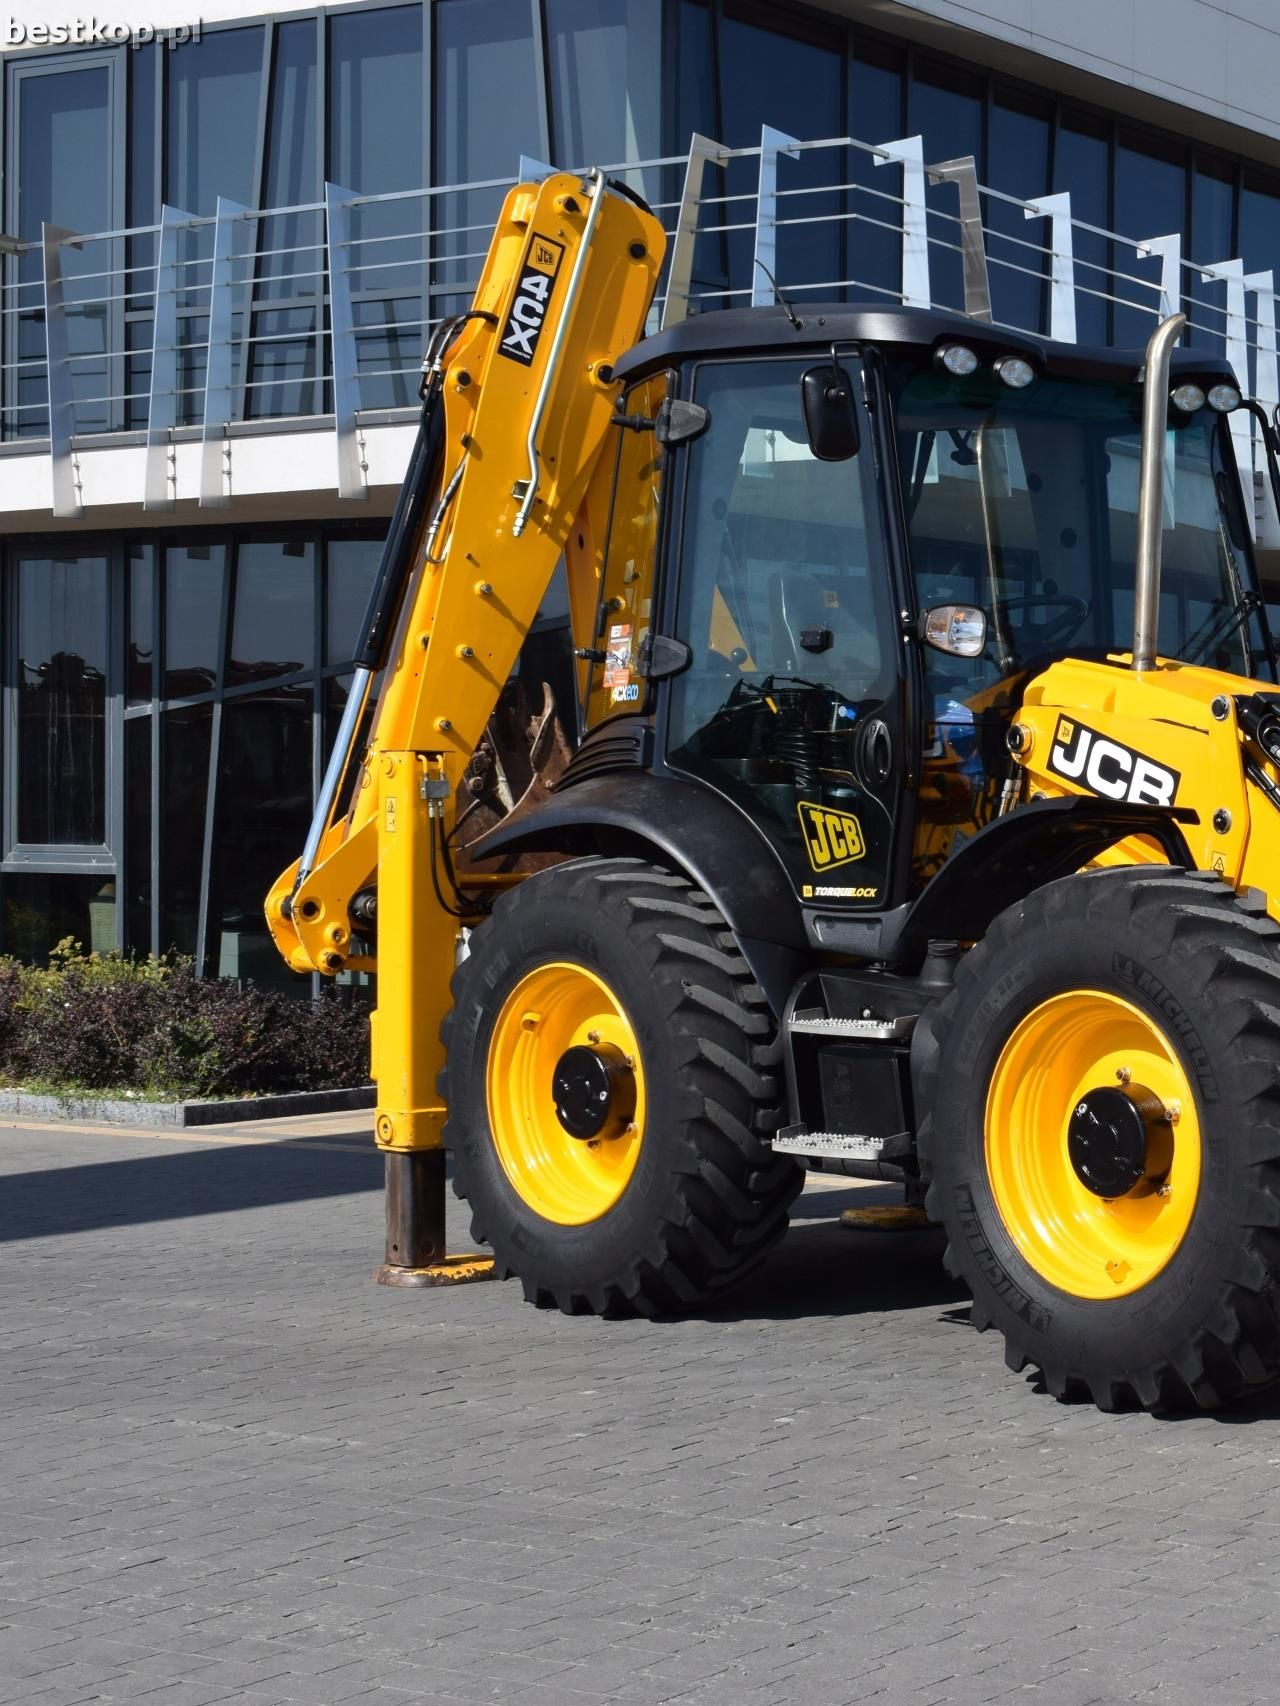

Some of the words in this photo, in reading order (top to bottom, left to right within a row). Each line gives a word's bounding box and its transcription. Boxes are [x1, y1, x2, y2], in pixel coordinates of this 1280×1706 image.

[502, 274, 550, 355] 4CX
[1052, 729, 1175, 807] JCB
[809, 809, 861, 865] JCB
[814, 886, 878, 898] TORQUELOCK
[1137, 970, 1222, 1103] MICHELIN
[951, 1184, 1029, 1313] MICHELIN
